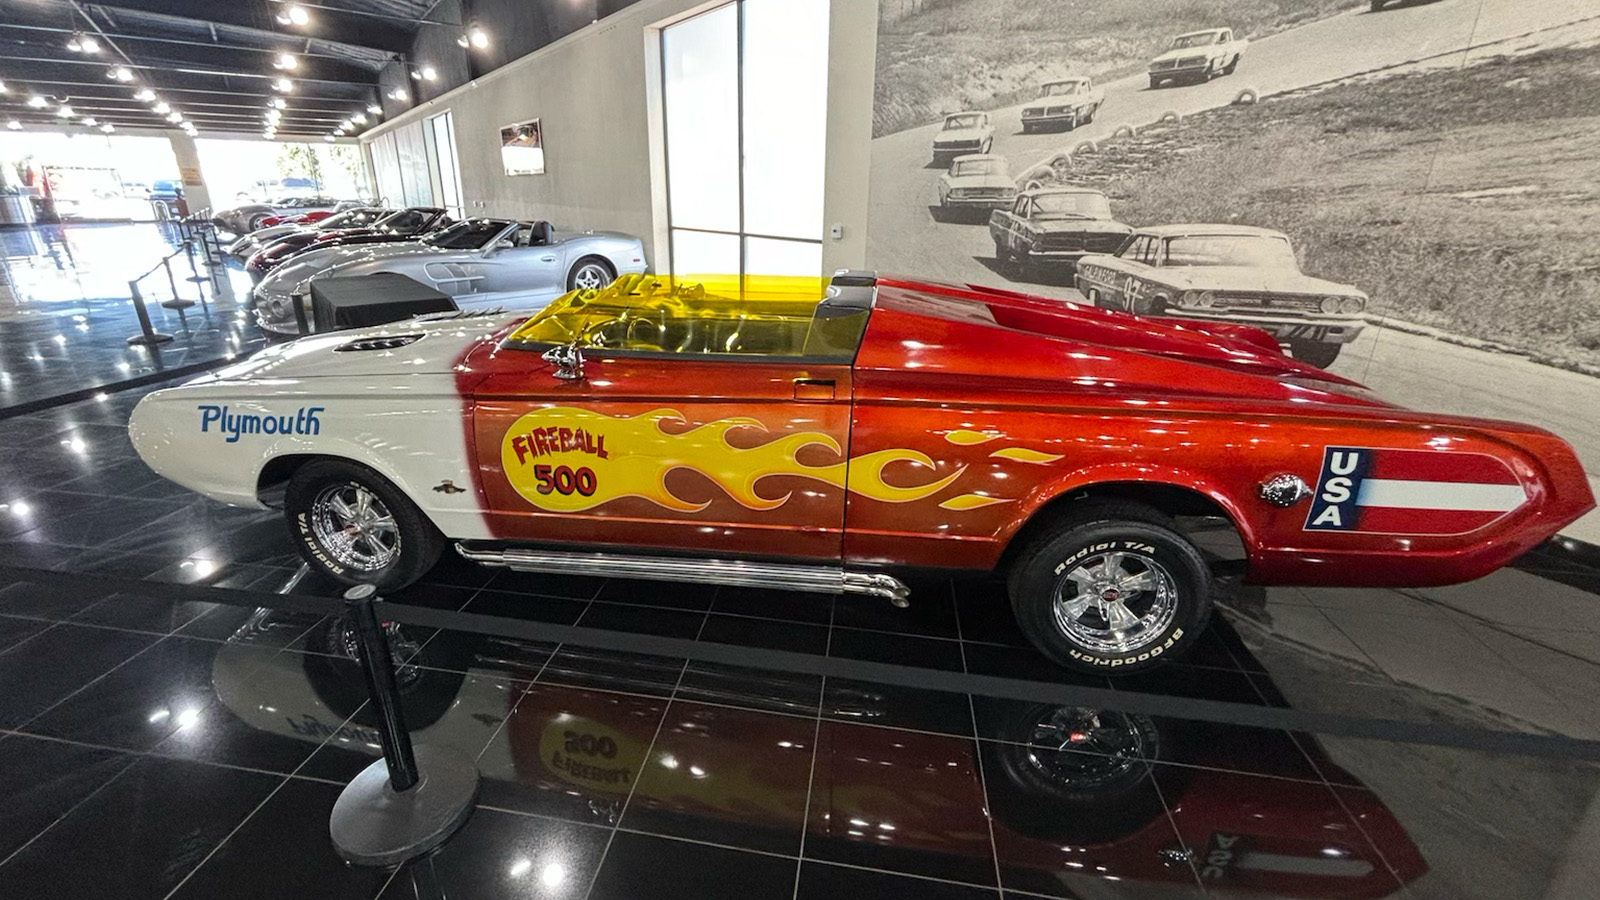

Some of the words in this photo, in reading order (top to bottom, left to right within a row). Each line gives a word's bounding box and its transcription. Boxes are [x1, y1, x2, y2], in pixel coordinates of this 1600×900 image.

[1122, 276, 1144, 314] 97
[197, 405, 325, 443] Plymouth
[511, 426, 609, 466] FIREBALL
[533, 464, 598, 497] 500
[1311, 451, 1359, 527] USA
[297, 512, 309, 535] T/A
[304, 537, 344, 575] Radial
[1054, 541, 1117, 576] Radial
[1124, 541, 1156, 555] T/A
[1069, 627, 1185, 668] BFGoodrich
